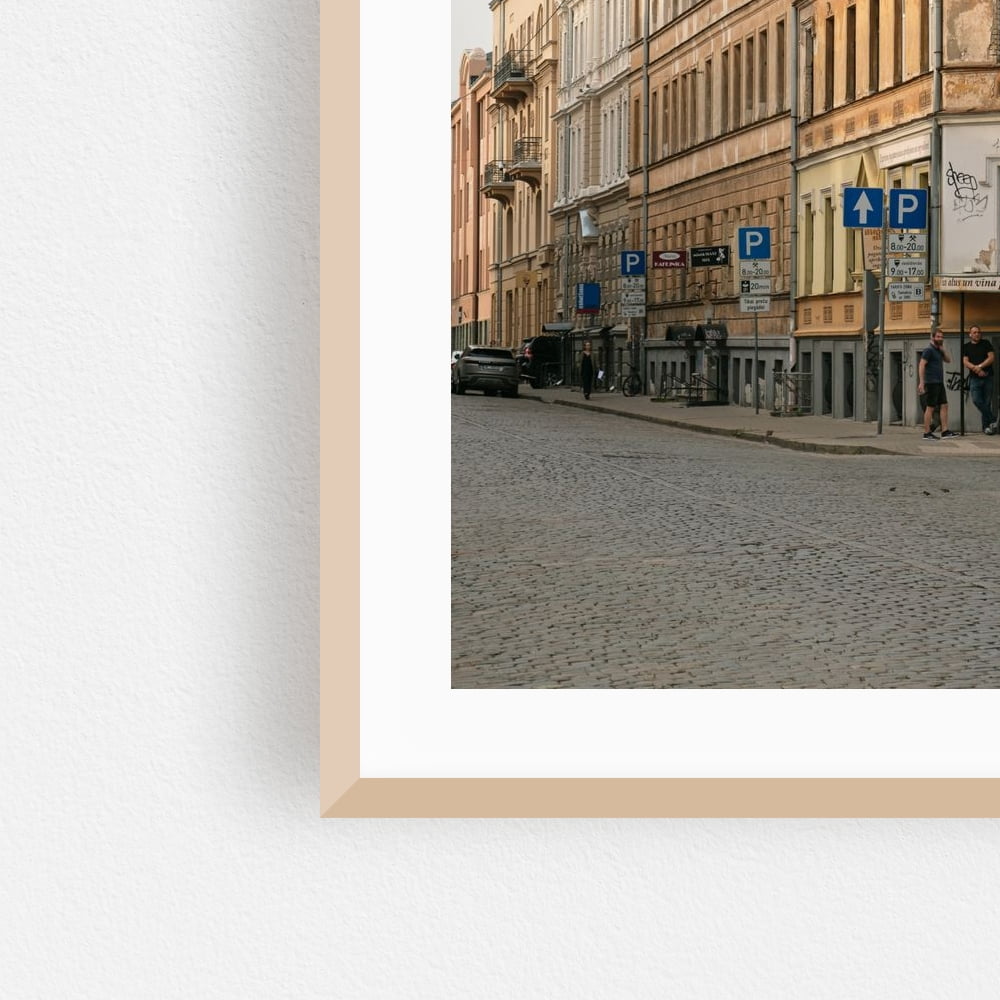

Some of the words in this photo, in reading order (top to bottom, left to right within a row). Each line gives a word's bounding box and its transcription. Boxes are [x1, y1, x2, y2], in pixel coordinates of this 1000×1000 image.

[897, 193, 919, 224] P
[745, 231, 764, 256] P
[626, 253, 640, 273] P
